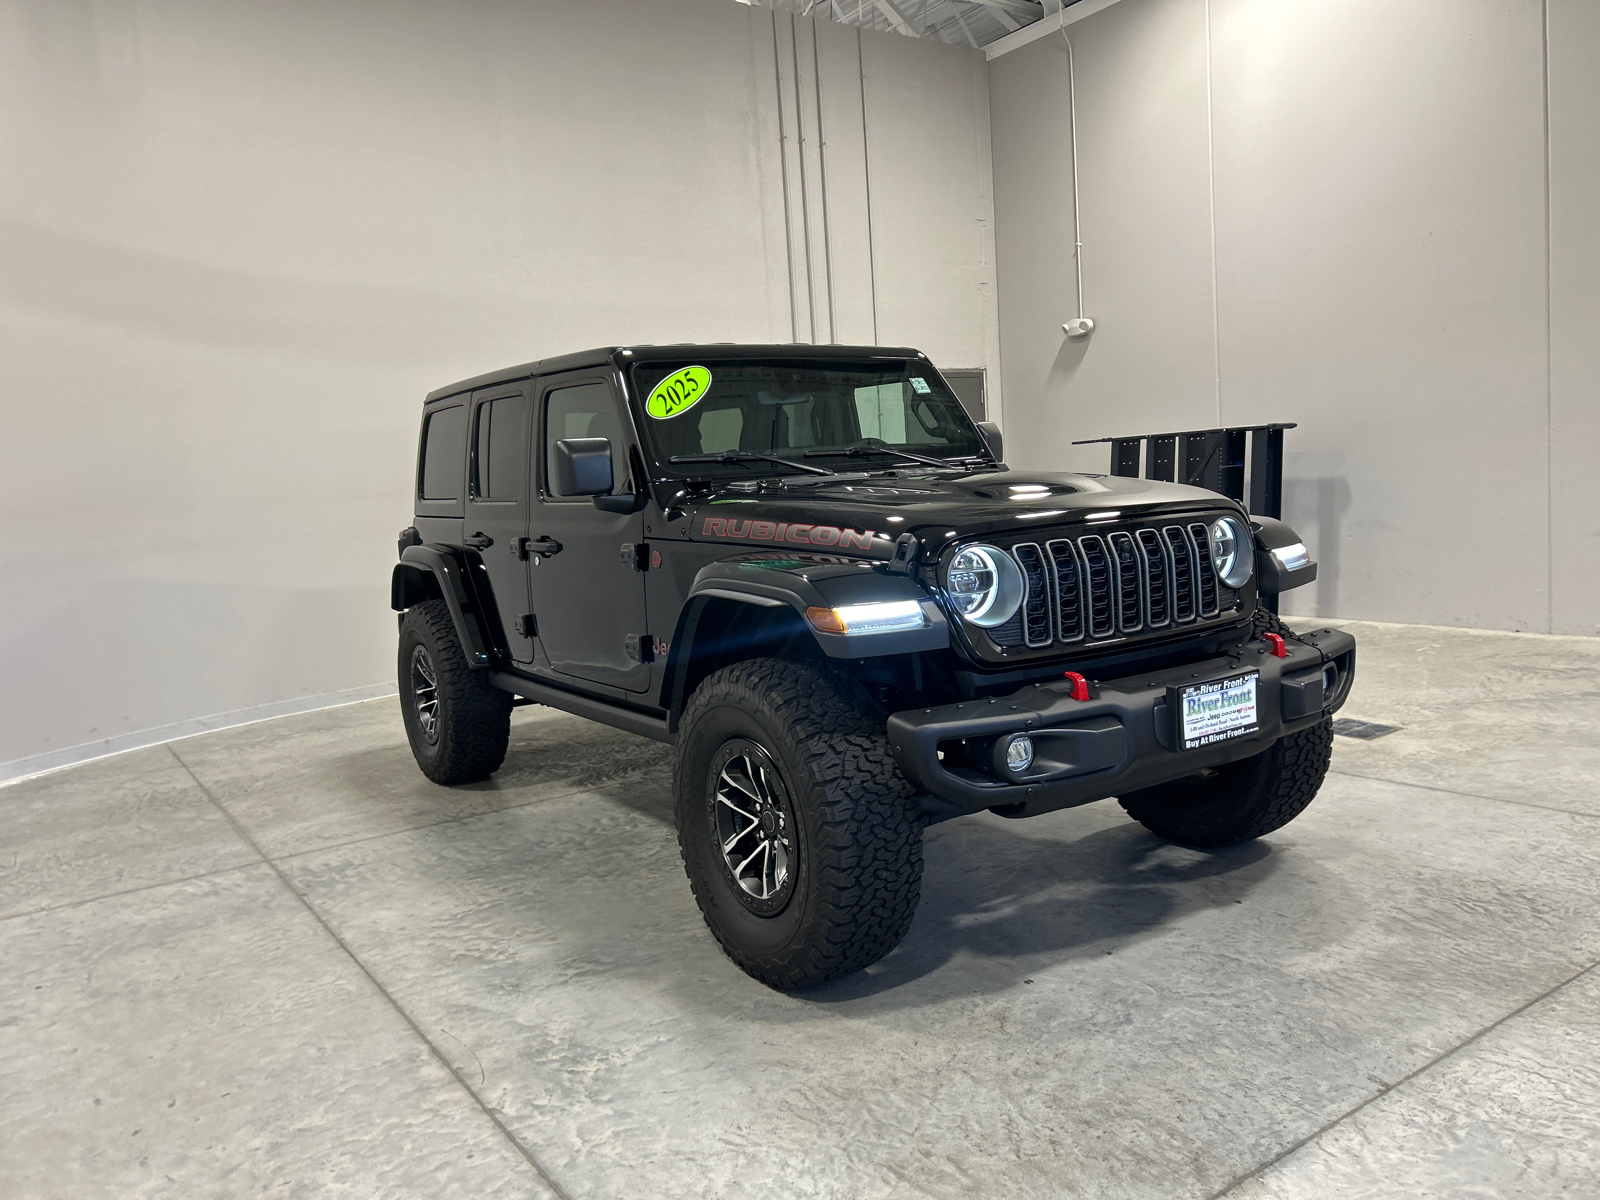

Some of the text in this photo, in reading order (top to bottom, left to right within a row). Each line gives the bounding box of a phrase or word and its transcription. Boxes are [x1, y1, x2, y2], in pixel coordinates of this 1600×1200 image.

[656, 370, 699, 415] 2025
[702, 517, 876, 550] RUBICON
[652, 636, 670, 657] Je
[1200, 685, 1221, 694] River
[1223, 678, 1243, 689] Front
[1186, 740, 1199, 748] Buy
[1200, 736, 1208, 745] At
[1209, 733, 1226, 743] River
